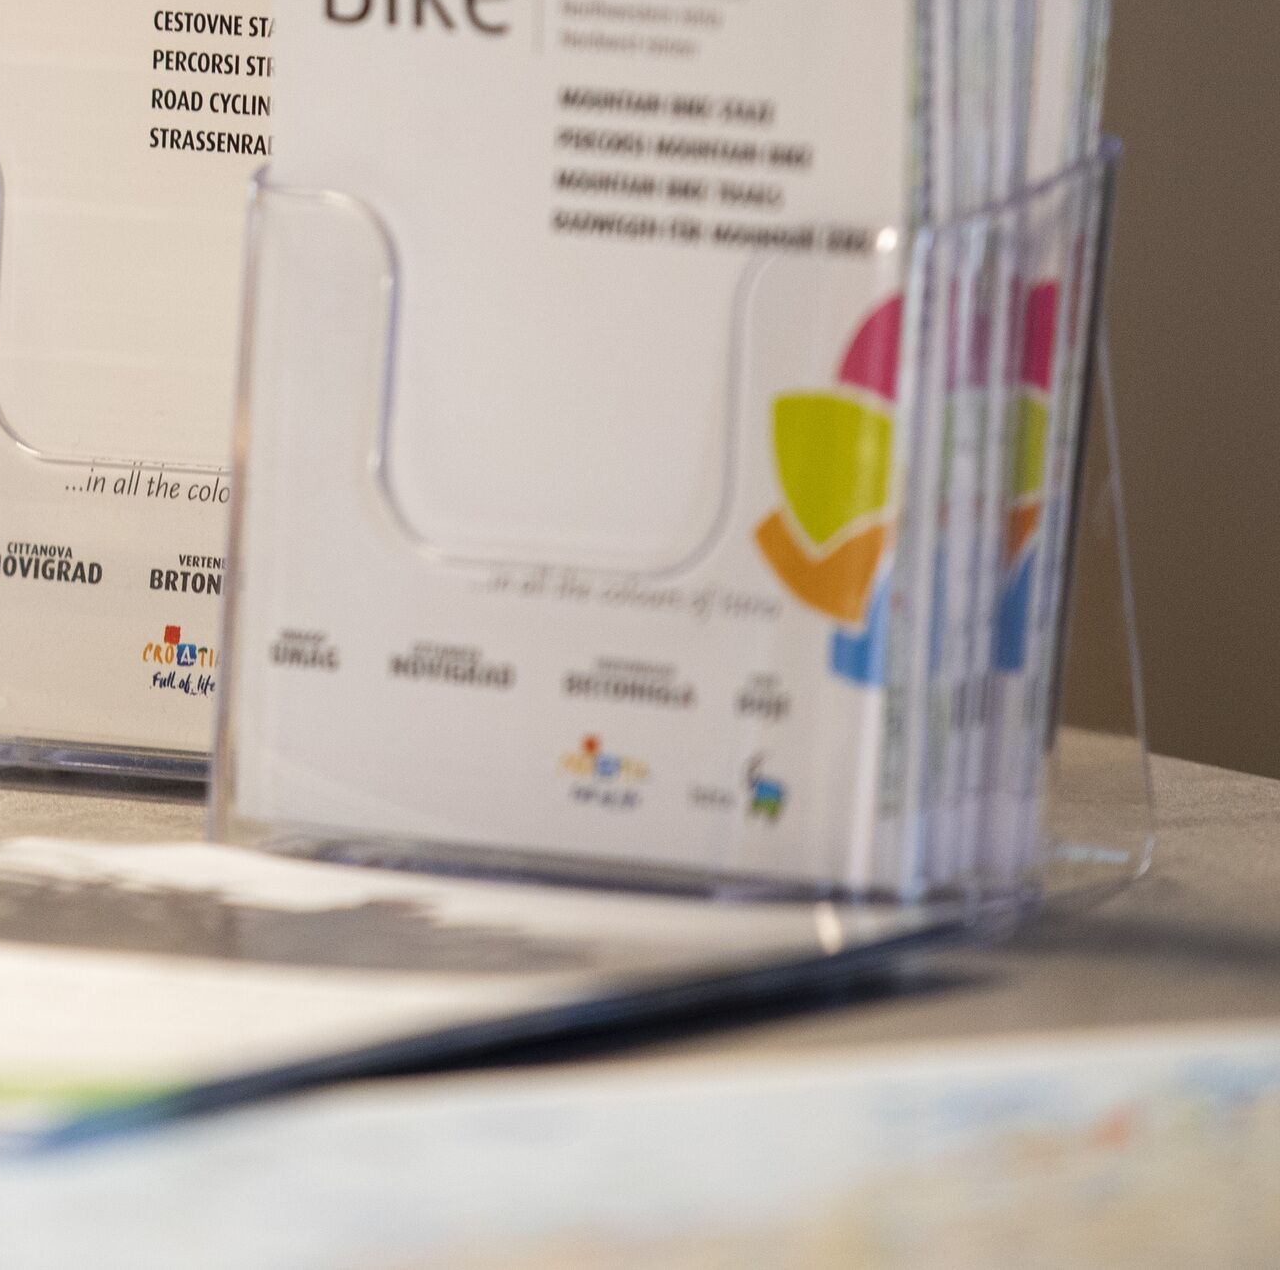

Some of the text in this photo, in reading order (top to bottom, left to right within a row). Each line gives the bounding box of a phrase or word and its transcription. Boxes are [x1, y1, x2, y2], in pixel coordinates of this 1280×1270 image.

[153, 10, 243, 37] CESTOVNE
[152, 49, 240, 75] PERCORSI
[151, 88, 271, 116] ROAD CYCLIN
[113, 461, 142, 496] all
[146, 463, 181, 499] the
[6, 541, 73, 559] CITTANOVA
[142, 641, 222, 668] CROATI
